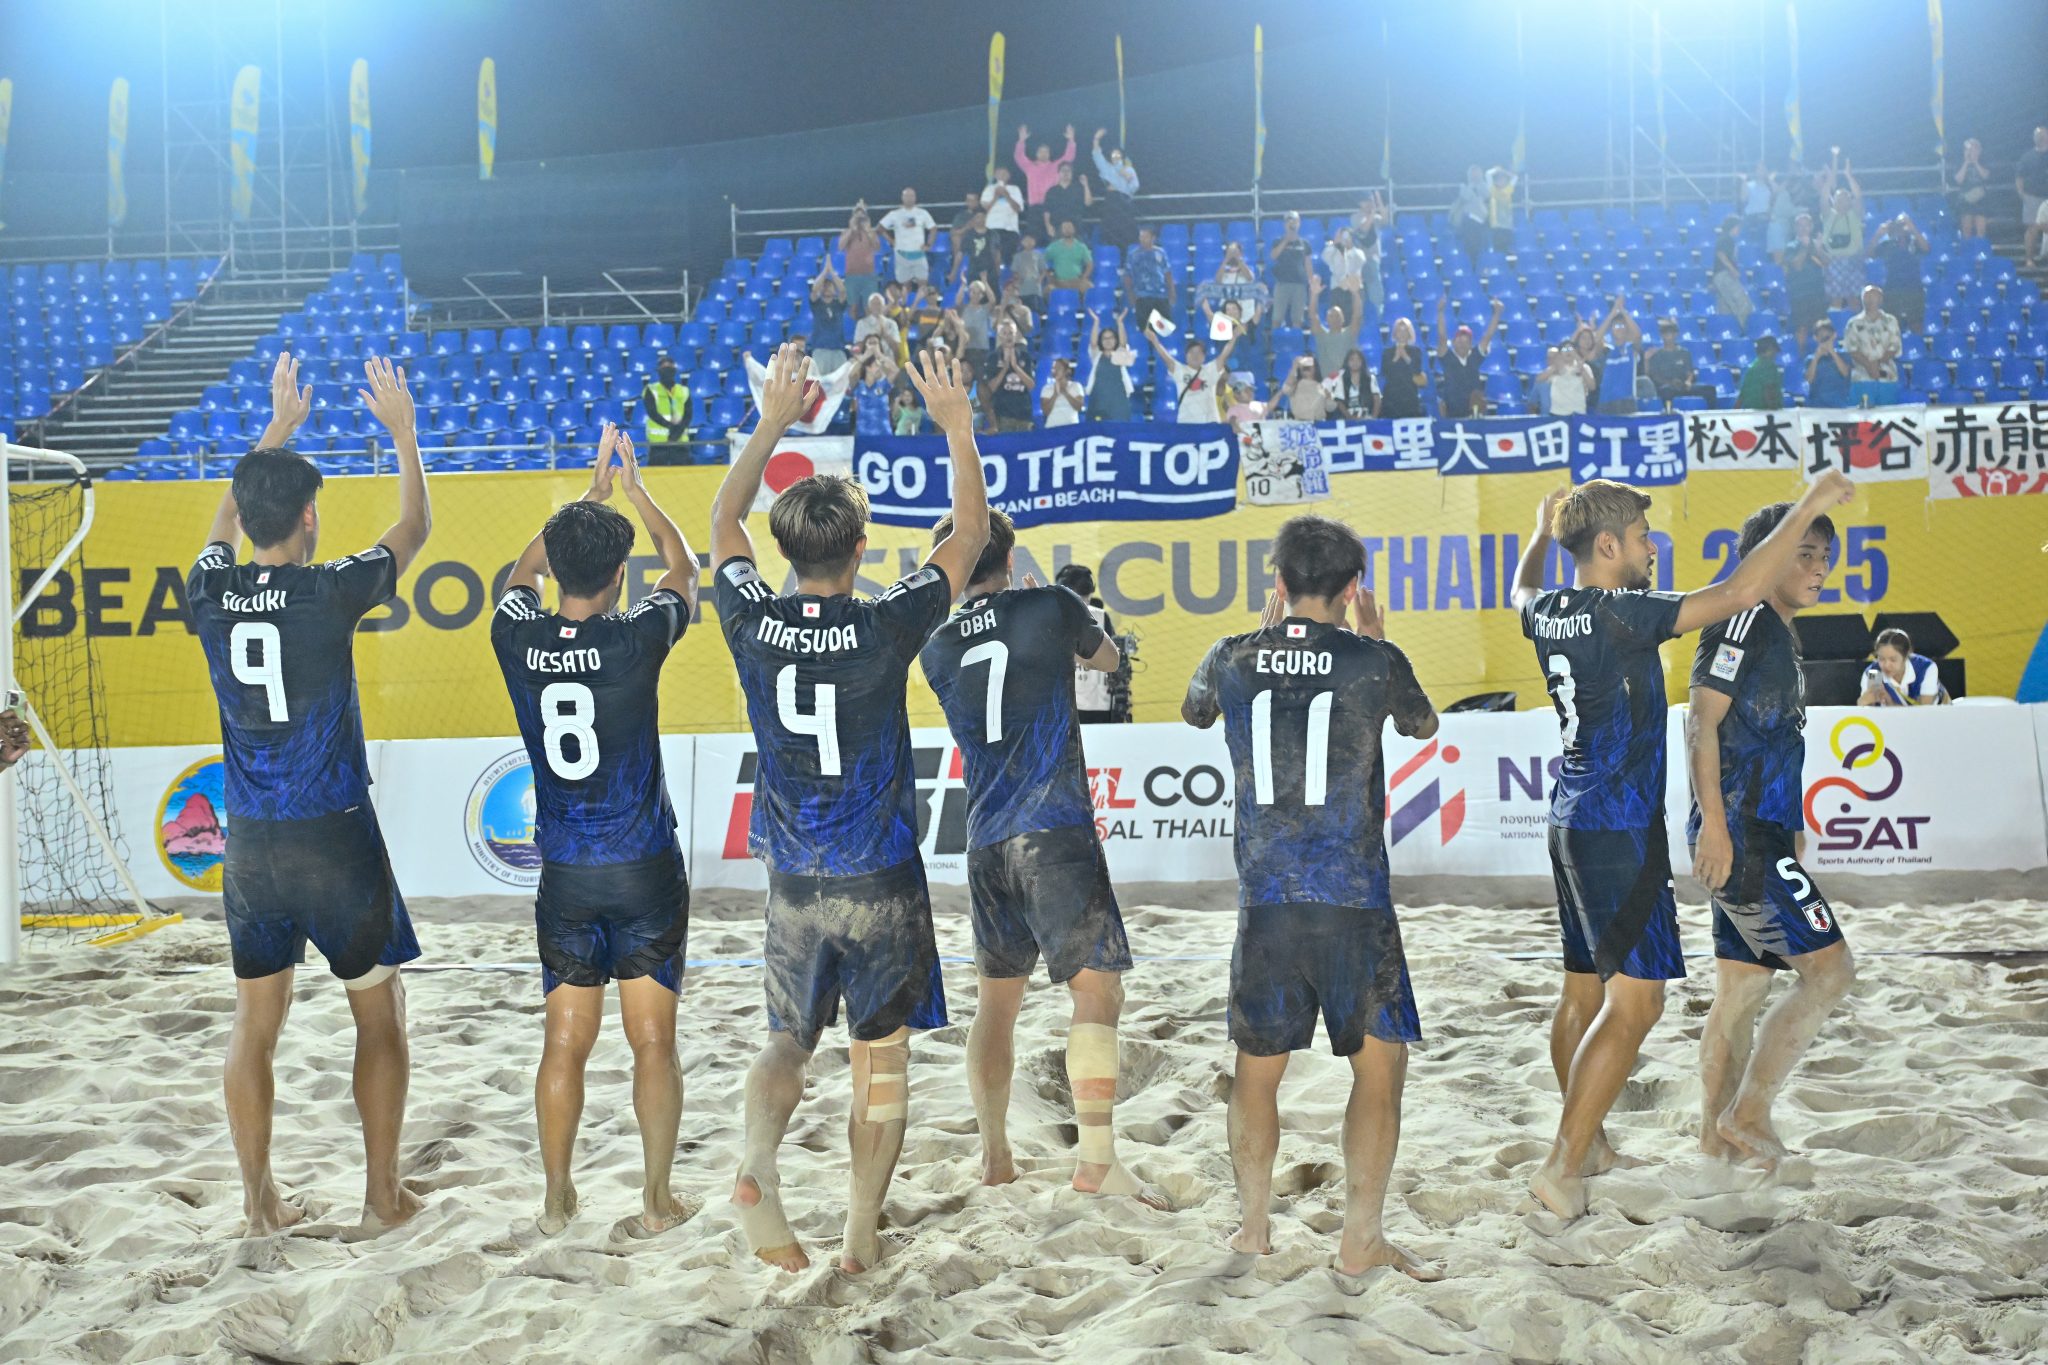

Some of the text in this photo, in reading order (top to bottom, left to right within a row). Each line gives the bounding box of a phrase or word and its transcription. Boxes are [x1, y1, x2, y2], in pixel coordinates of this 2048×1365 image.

[1317, 418, 1438, 473] 古里
[1440, 421, 1570, 474] 大田
[1578, 421, 1685, 481] 江黒
[1688, 414, 1799, 464] 松本
[1807, 416, 1923, 474] 坪谷
[859, 451, 926, 499] GO
[1017, 436, 1118, 492] THE
[1128, 439, 1230, 486] TOP
[1250, 478, 1271, 497] 10
[1055, 488, 1114, 507] BEACH
[20, 566, 201, 638] BEA
[222, 589, 287, 613] SUZUKI
[960, 609, 998, 638] OBA
[756, 615, 858, 654] MATSUDA
[230, 622, 289, 722] 9
[526, 648, 601, 673] UESATO
[1256, 649, 1333, 675] EGURO
[960, 640, 1009, 744] 7
[540, 682, 600, 781] 8
[776, 664, 842, 776] 4
[1251, 689, 1334, 806] 11
[1153, 818, 1234, 840] THAIL
[1501, 831, 1545, 840] NATIONAL
[1817, 816, 1931, 851] SAT
[473, 841, 540, 884] MINISTRY OF TOURI
[1775, 856, 1811, 902] 5
[1817, 856, 1933, 866] Sports Authority of Thailand
